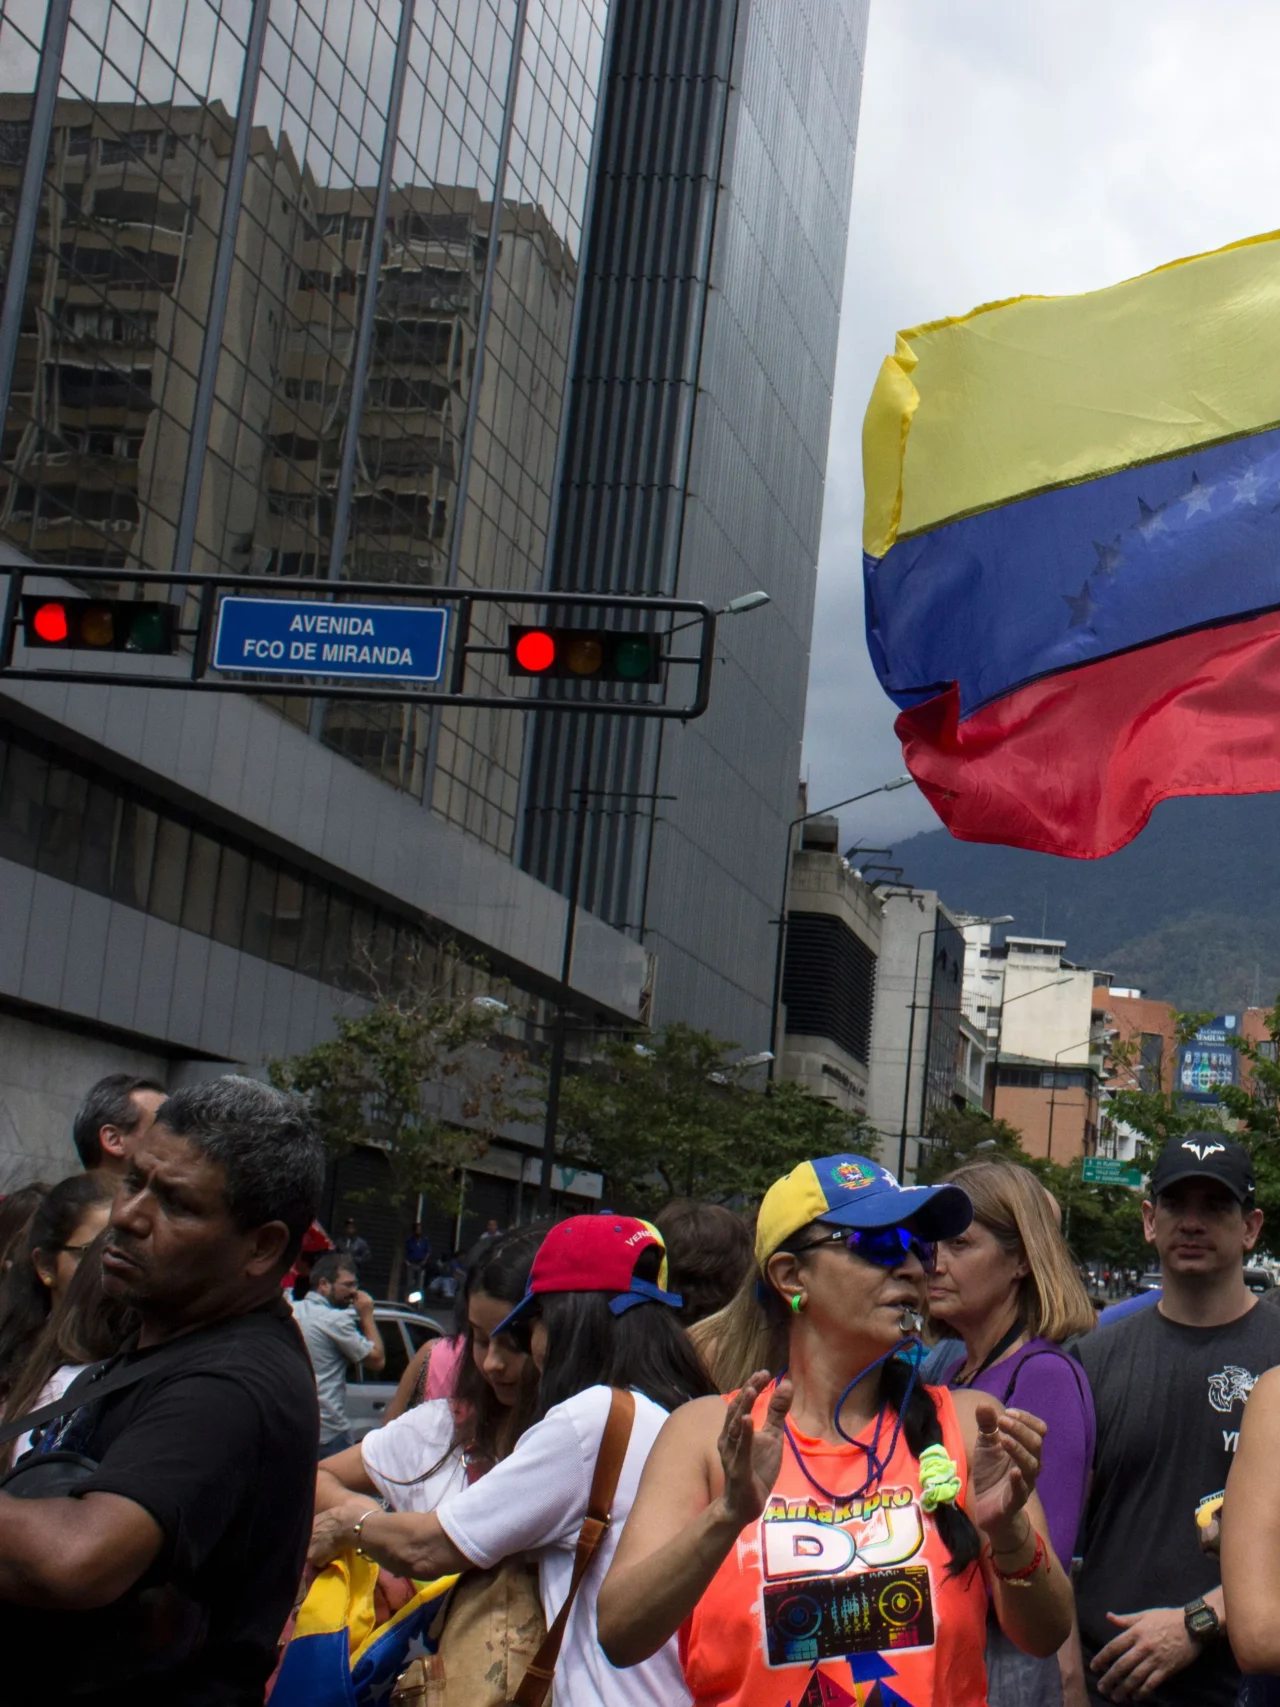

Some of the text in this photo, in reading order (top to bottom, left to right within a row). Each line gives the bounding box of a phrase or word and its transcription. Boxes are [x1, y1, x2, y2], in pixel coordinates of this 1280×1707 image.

[289, 614, 375, 636] AVENIDA
[243, 639, 413, 666] FCO DE MIRANDA
[761, 1503, 924, 1583] DJ
